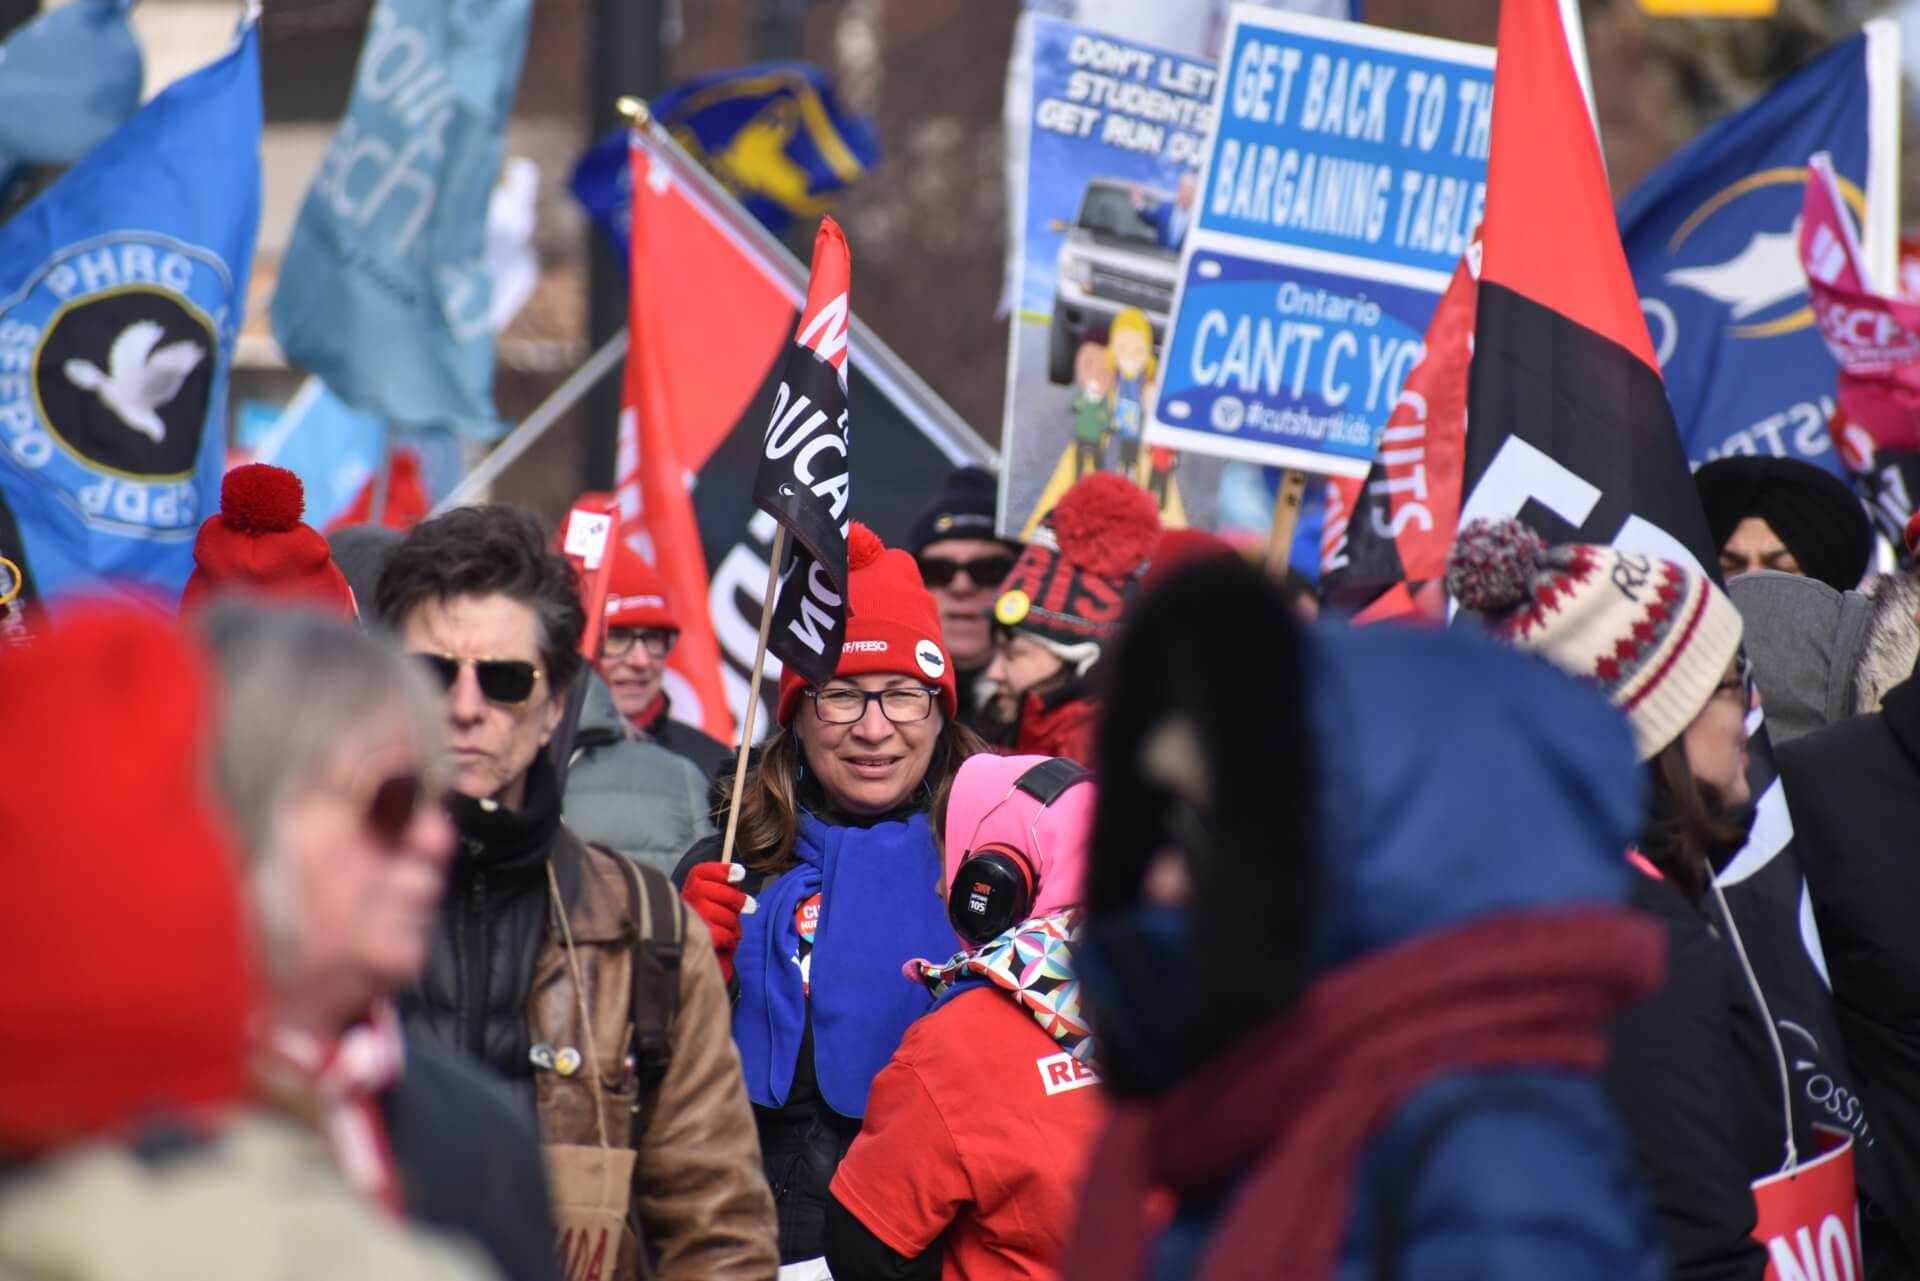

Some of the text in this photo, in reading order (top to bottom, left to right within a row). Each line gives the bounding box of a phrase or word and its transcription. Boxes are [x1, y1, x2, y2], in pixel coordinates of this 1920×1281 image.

[1157, 57, 1216, 98] LET
[1232, 40, 1493, 160] GET BACK TO TH
[1036, 97, 1101, 139] GET
[1101, 114, 1165, 155] RUN
[1211, 138, 1393, 244] BARGAINING
[45, 244, 193, 299] PHRC
[1277, 281, 1381, 328] Ontario
[1321, 330, 1358, 407] C
[970, 899, 986, 913] 105
[1047, 1056, 1096, 1086] RE
